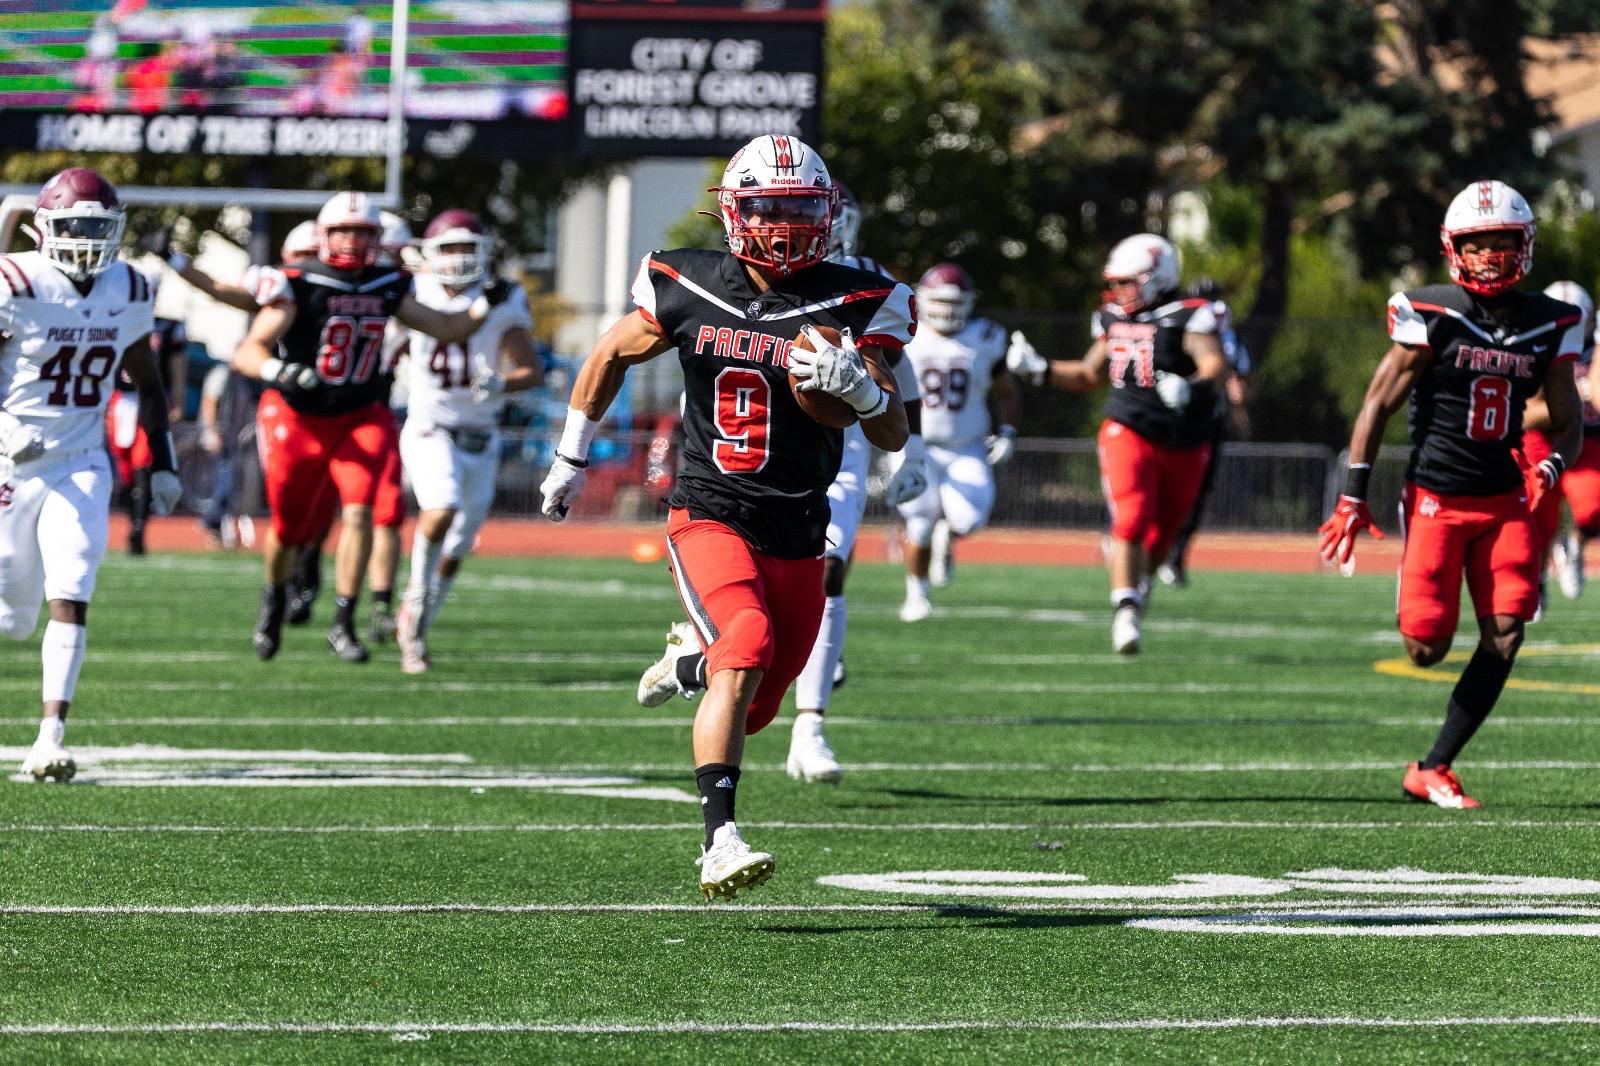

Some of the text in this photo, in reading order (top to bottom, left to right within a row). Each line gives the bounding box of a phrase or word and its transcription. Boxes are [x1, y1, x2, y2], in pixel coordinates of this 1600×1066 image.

[632, 38, 763, 71] CITY OF
[575, 69, 816, 108] FOREST GROVE
[37, 114, 142, 152] HOME
[145, 116, 198, 153] OF
[202, 117, 271, 155] THE
[585, 105, 802, 139] LINCOLN PARK
[47, 327, 119, 342] PUGET SOUND
[316, 316, 387, 385] 87
[40, 346, 117, 407] 48
[430, 337, 472, 388] 41
[1455, 344, 1535, 378] PACIFIC
[712, 367, 771, 474] 9
